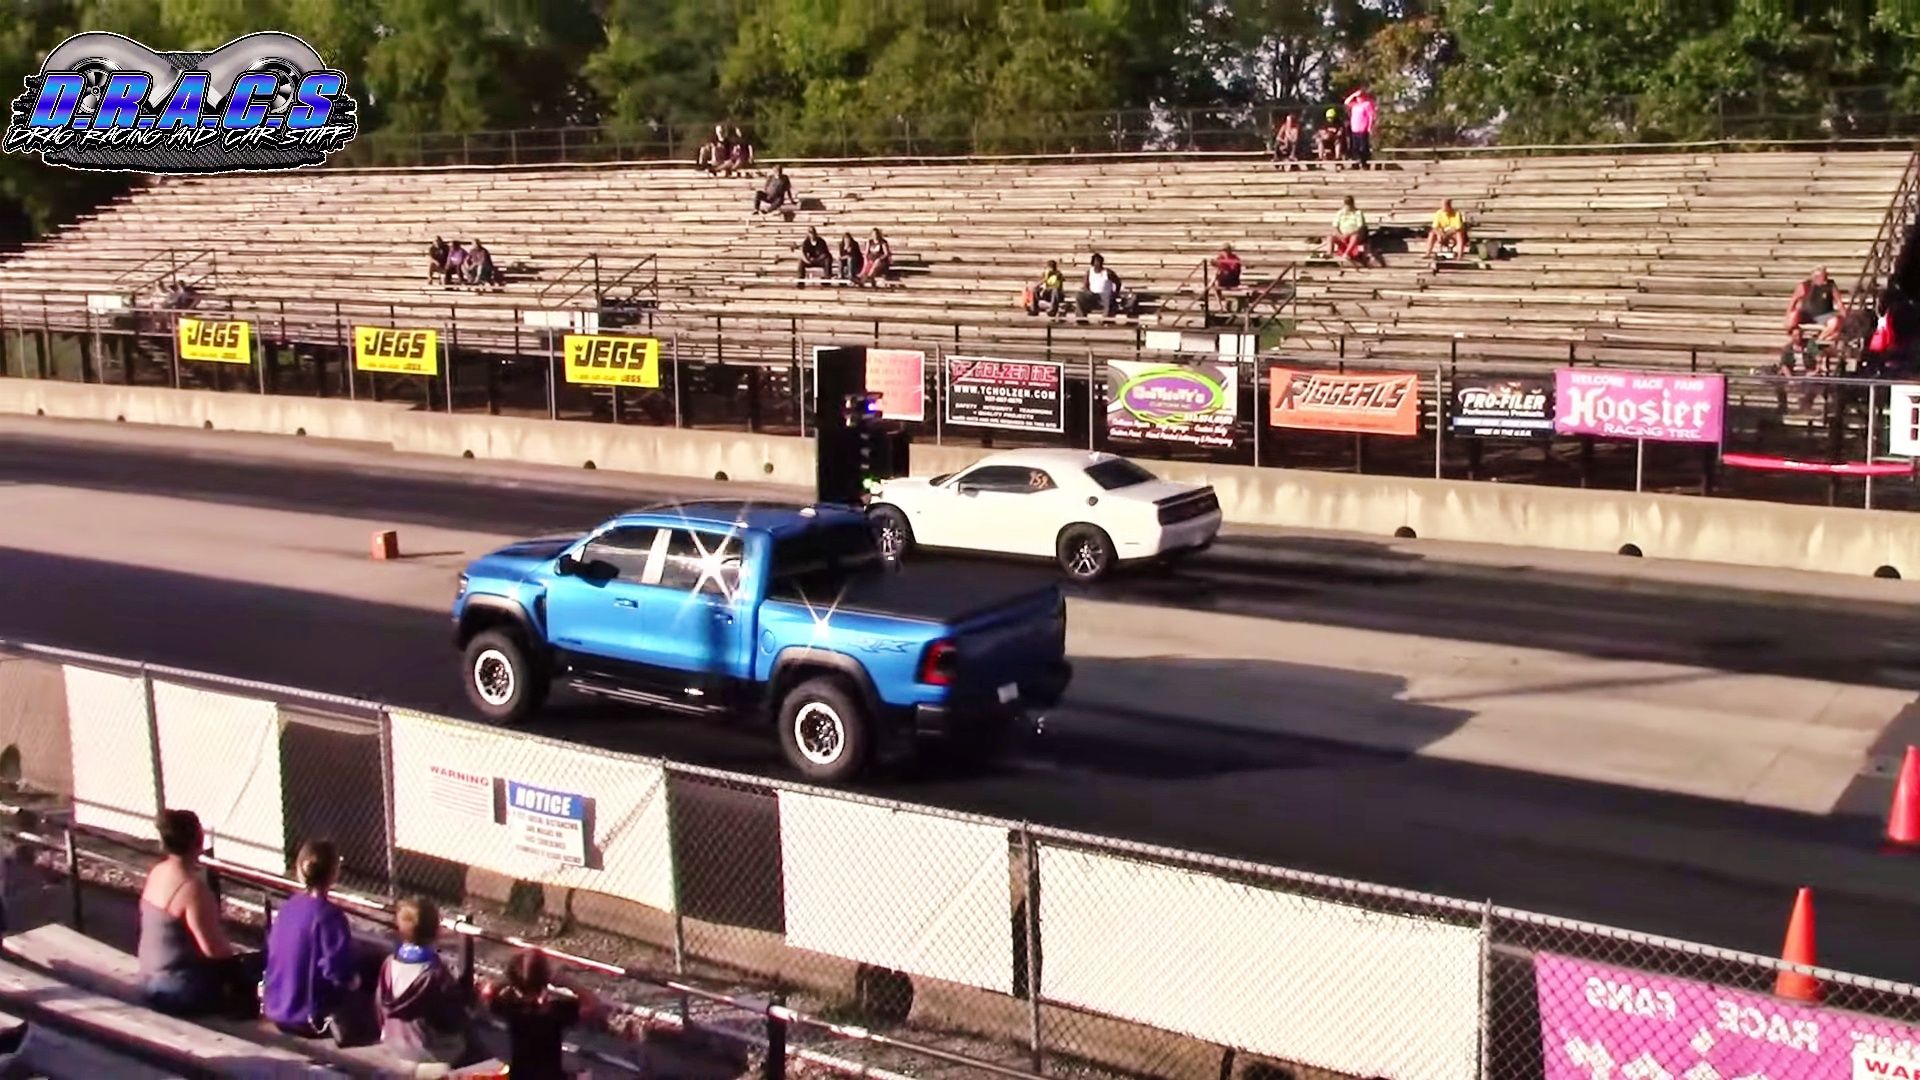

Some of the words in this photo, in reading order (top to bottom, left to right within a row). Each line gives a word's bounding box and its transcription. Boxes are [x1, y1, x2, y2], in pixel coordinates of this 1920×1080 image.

[187, 322, 240, 348] JEGS
[364, 331, 426, 359] JEGS
[574, 340, 646, 370] JEGS
[953, 385, 1057, 400] WWW.TCHOLZEN.COM
[1632, 378, 1663, 389] RACE
[1463, 392, 1546, 410] PRO-FILER
[1560, 386, 1711, 428] Hoosier
[1604, 423, 1664, 437] RACING
[1667, 428, 1701, 439] TIRE
[430, 766, 488, 787] WARNING
[515, 786, 571, 816] NOTICE
